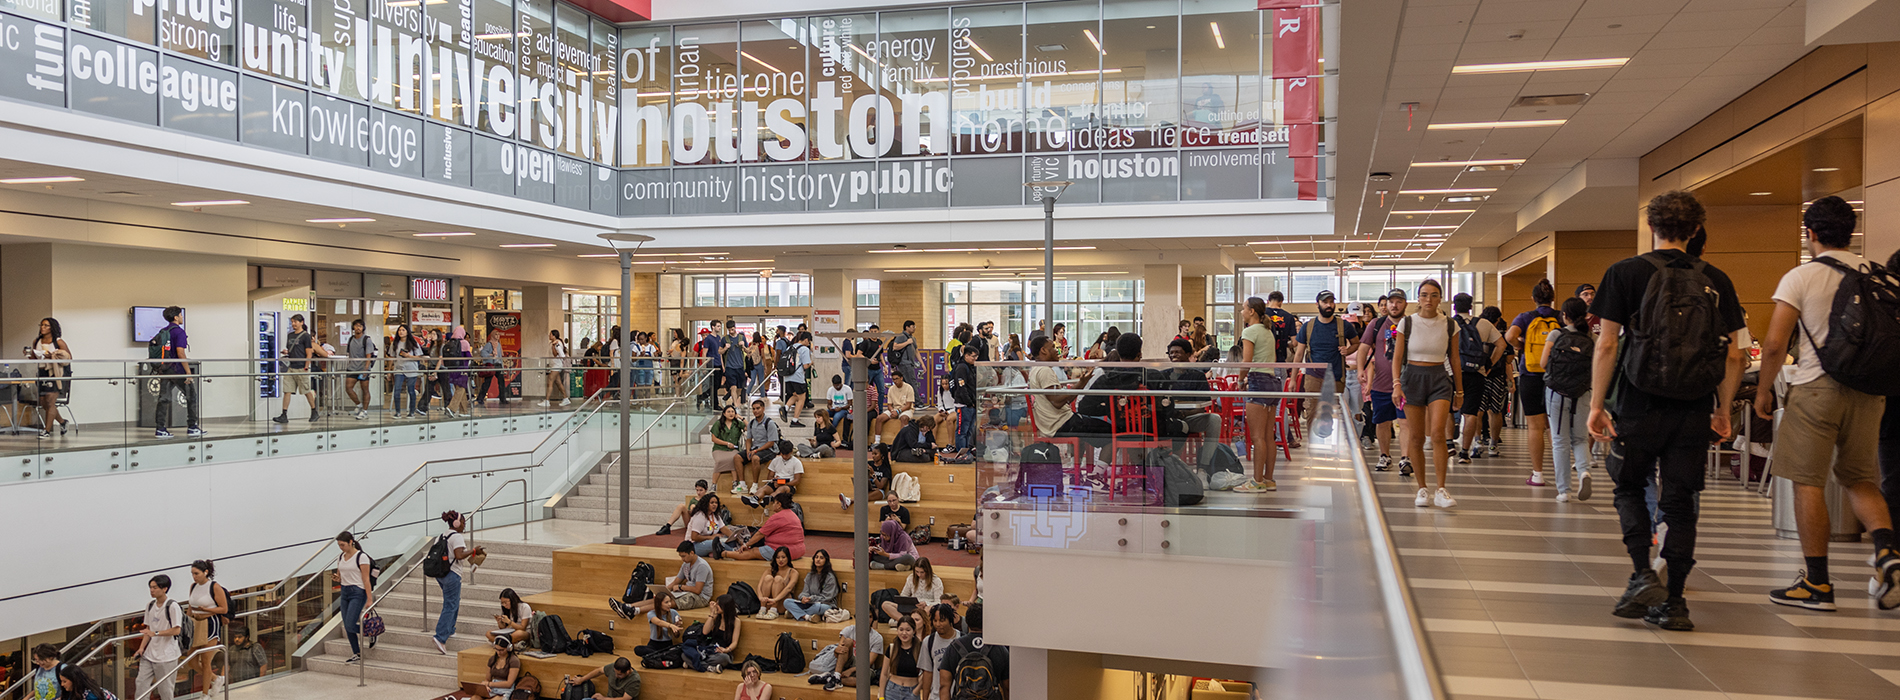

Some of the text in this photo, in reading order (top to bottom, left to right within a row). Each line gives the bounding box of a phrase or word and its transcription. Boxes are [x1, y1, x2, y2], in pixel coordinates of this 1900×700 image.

[162, 16, 220, 61] strong
[274, 4, 296, 33] life
[521, 0, 533, 71] recogniz
[839, 17, 853, 48] white
[1279, 17, 1300, 38] R
[27, 23, 64, 92] fun
[244, 23, 345, 100] unity
[473, 37, 515, 65] education
[537, 33, 601, 73] achievement
[606, 33, 617, 101] learning
[621, 37, 660, 83] of
[819, 19, 836, 77] culture
[865, 37, 936, 61] energy
[953, 17, 975, 98] progress
[71, 44, 237, 112] colleague
[537, 56, 564, 84] impact
[674, 36, 700, 101] urban
[705, 68, 804, 100] tier one
[839, 75, 853, 93] red
[883, 61, 935, 85] family
[981, 58, 1067, 80] prestigious
[355, 17, 617, 181] university
[980, 81, 1051, 111] build
[1080, 97, 1152, 120] frontier
[273, 85, 417, 168] knowledge
[621, 80, 948, 166] houston
[955, 110, 1067, 152] home
[1072, 122, 1135, 149] ideas
[1208, 110, 1243, 123] cutting
[443, 126, 452, 180] inclusive
[501, 143, 555, 186] open
[557, 157, 583, 175] flawless
[1067, 153, 1178, 180] houston
[1189, 151, 1276, 167] involvement
[623, 175, 732, 202] community
[742, 167, 845, 208] history
[850, 160, 954, 203] public
[1031, 156, 1043, 202] opprtunity
[1041, 157, 1059, 193] cvic
